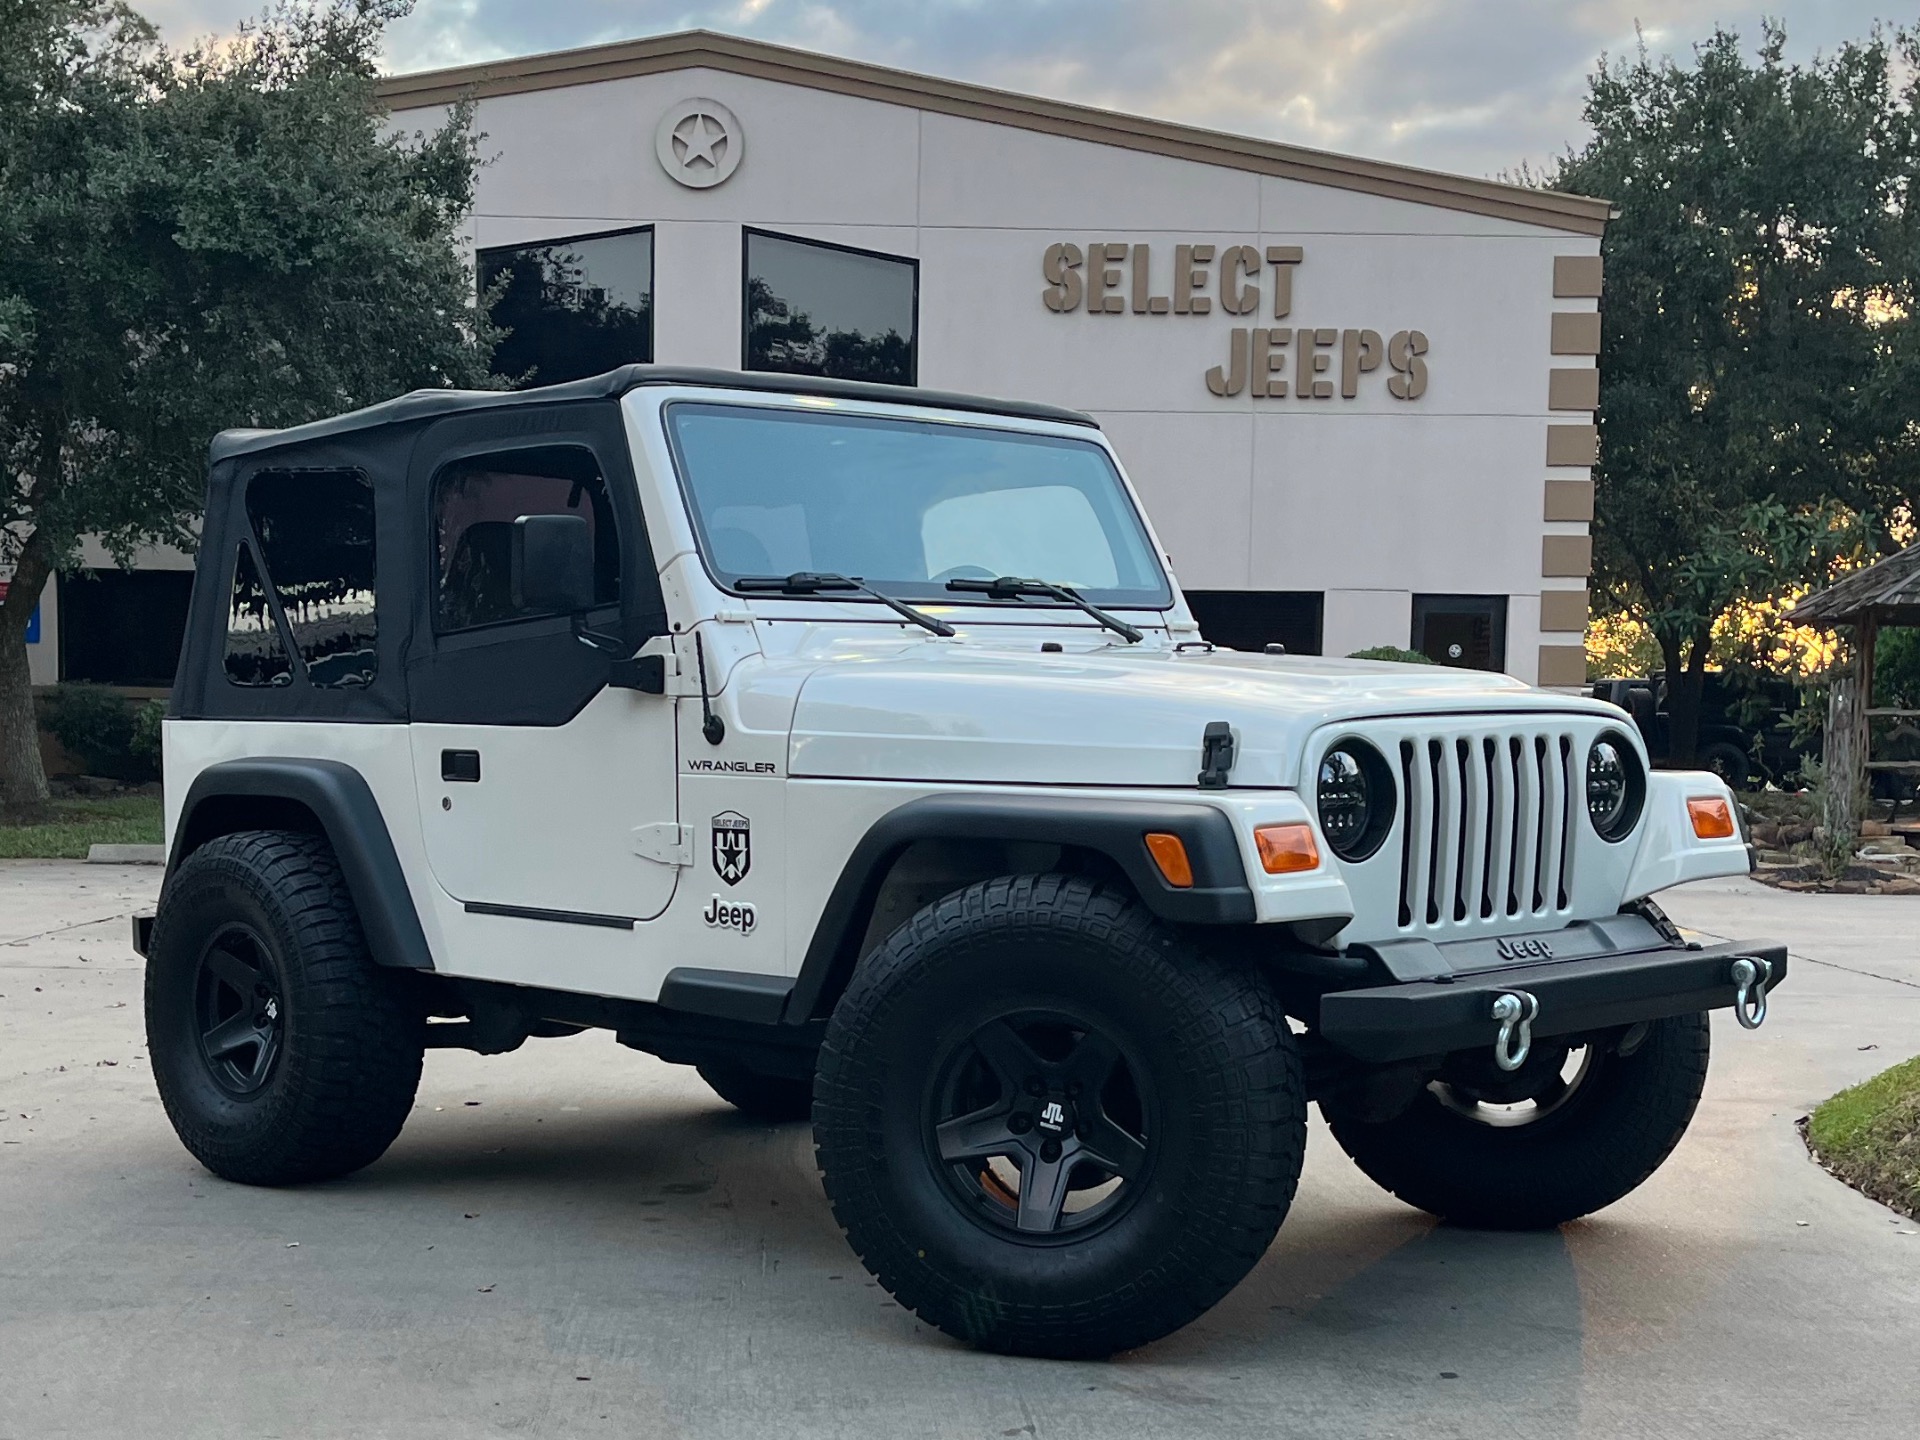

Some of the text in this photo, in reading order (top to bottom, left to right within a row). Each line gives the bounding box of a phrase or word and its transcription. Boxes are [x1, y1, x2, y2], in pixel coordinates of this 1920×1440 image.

[1042, 242, 1303, 319] SELECT
[1205, 328, 1429, 399] JEEPS
[687, 759, 776, 774] WRANGLER
[713, 819, 749, 829] SELECT JEEPS
[704, 897, 755, 932] Jeep
[1497, 938, 1553, 960] Jeep
